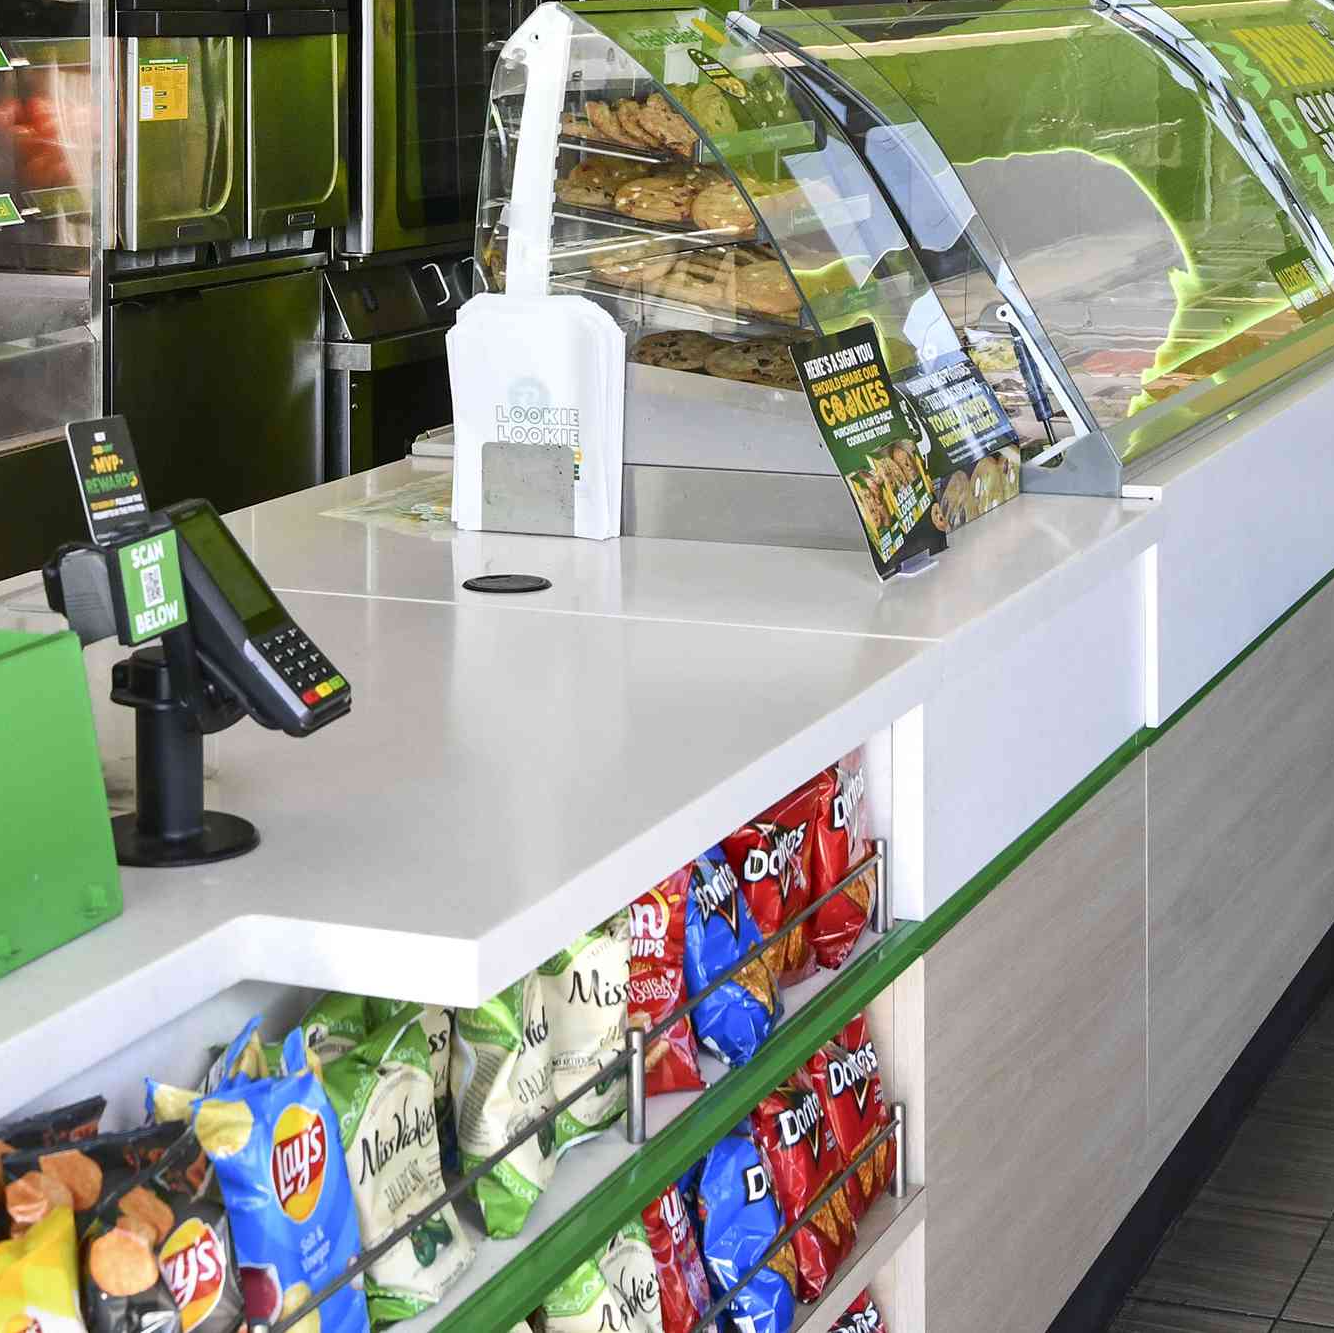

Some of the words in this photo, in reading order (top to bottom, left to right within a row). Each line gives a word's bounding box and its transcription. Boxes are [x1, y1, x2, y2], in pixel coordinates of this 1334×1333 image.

[804, 356, 833, 380] HERE'S
[855, 343, 874, 363] YOU
[812, 377, 841, 397] SHOULD
[840, 370, 864, 389] SHARE
[863, 364, 880, 379] OUR
[496, 405, 579, 426] LOOKIE
[819, 379, 890, 427] COOKIES
[498, 425, 579, 447] LOOKIE
[86, 470, 139, 495] REWARDS
[131, 539, 165, 569] SCAN
[135, 600, 179, 635] BELOW
[743, 821, 806, 882] Doritos
[828, 1041, 877, 1098] Doritos
[271, 1120, 325, 1202] Lay's
